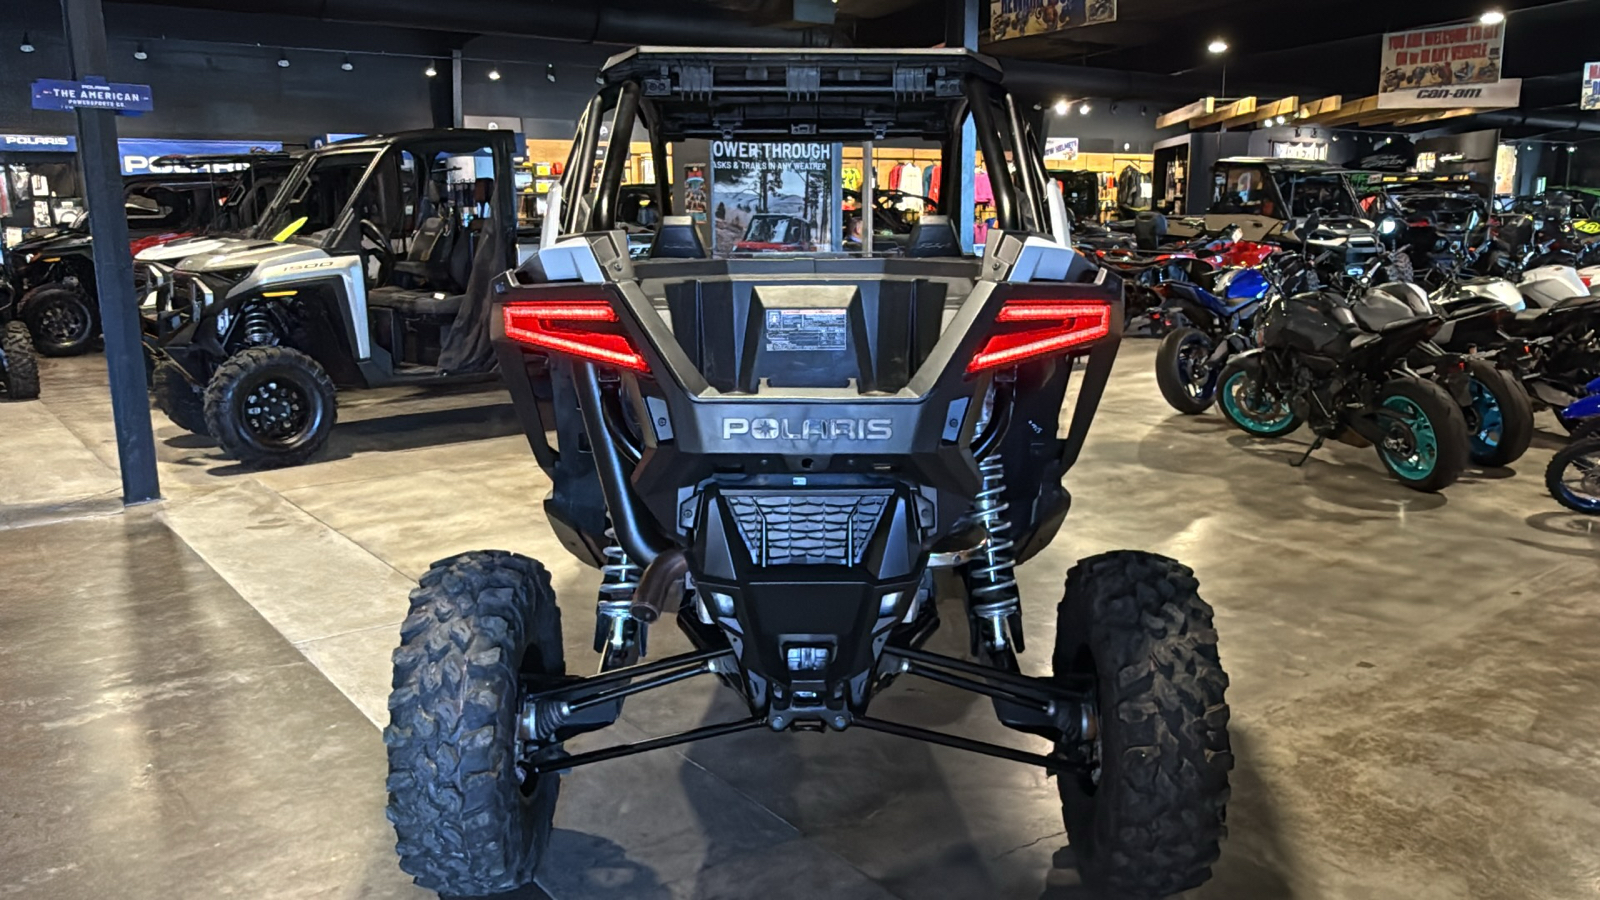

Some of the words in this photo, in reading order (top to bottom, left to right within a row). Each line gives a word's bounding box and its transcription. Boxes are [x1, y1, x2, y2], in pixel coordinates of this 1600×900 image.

[53, 88, 76, 98] THE
[80, 90, 140, 102] AMERICAN
[1416, 88, 1482, 99] can-am
[5, 136, 69, 145] POLARIS
[762, 143, 830, 159] THROUGH
[733, 161, 739, 169] &
[740, 161, 767, 170] TRAILS
[768, 162, 776, 170] IN
[778, 162, 791, 170] ANY
[793, 162, 827, 170] WEATHER
[283, 261, 334, 272] 1500
[723, 418, 893, 440] POLARIS
